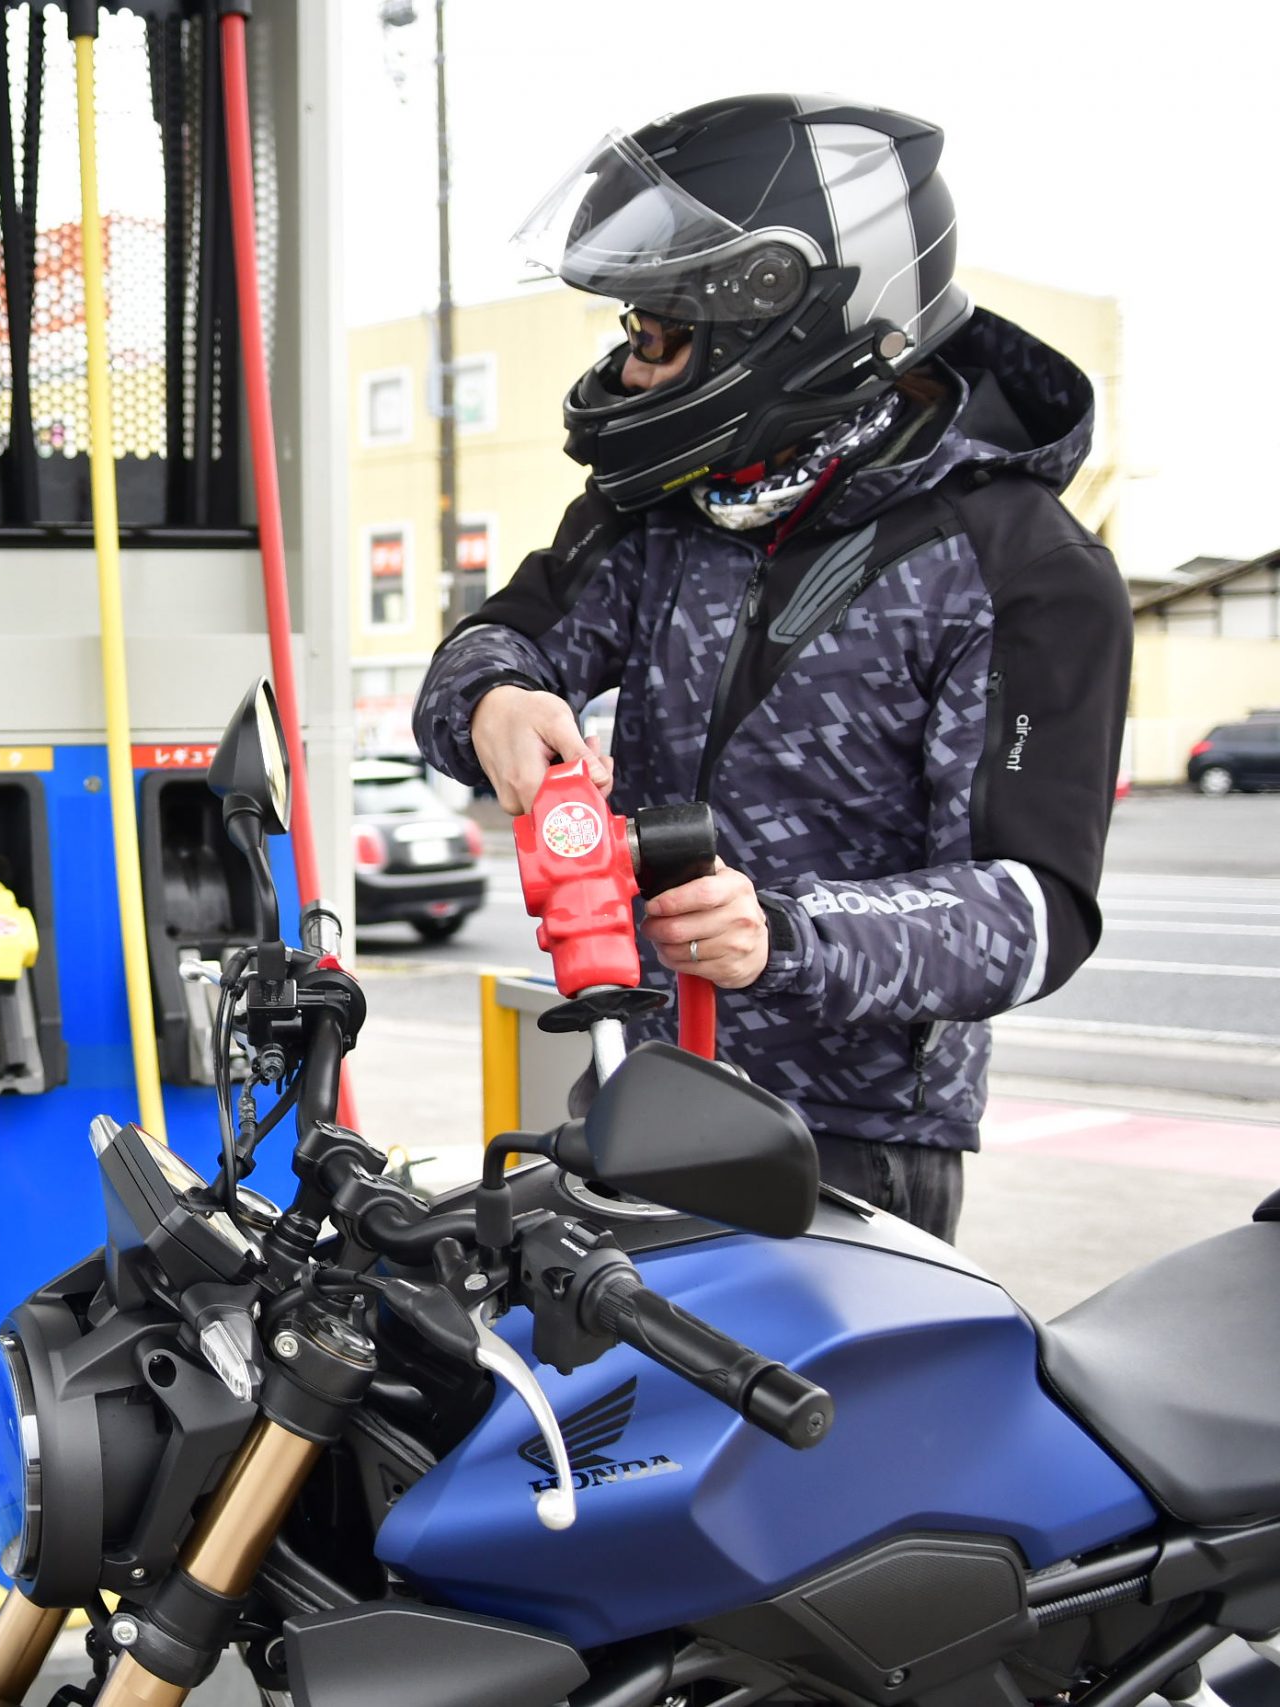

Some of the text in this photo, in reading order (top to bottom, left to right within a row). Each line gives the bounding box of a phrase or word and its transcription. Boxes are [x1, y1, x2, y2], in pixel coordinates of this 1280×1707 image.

[1006, 713, 1033, 772] air-vent
[797, 883, 965, 918] HONDA
[528, 1454, 678, 1494] HONDA
